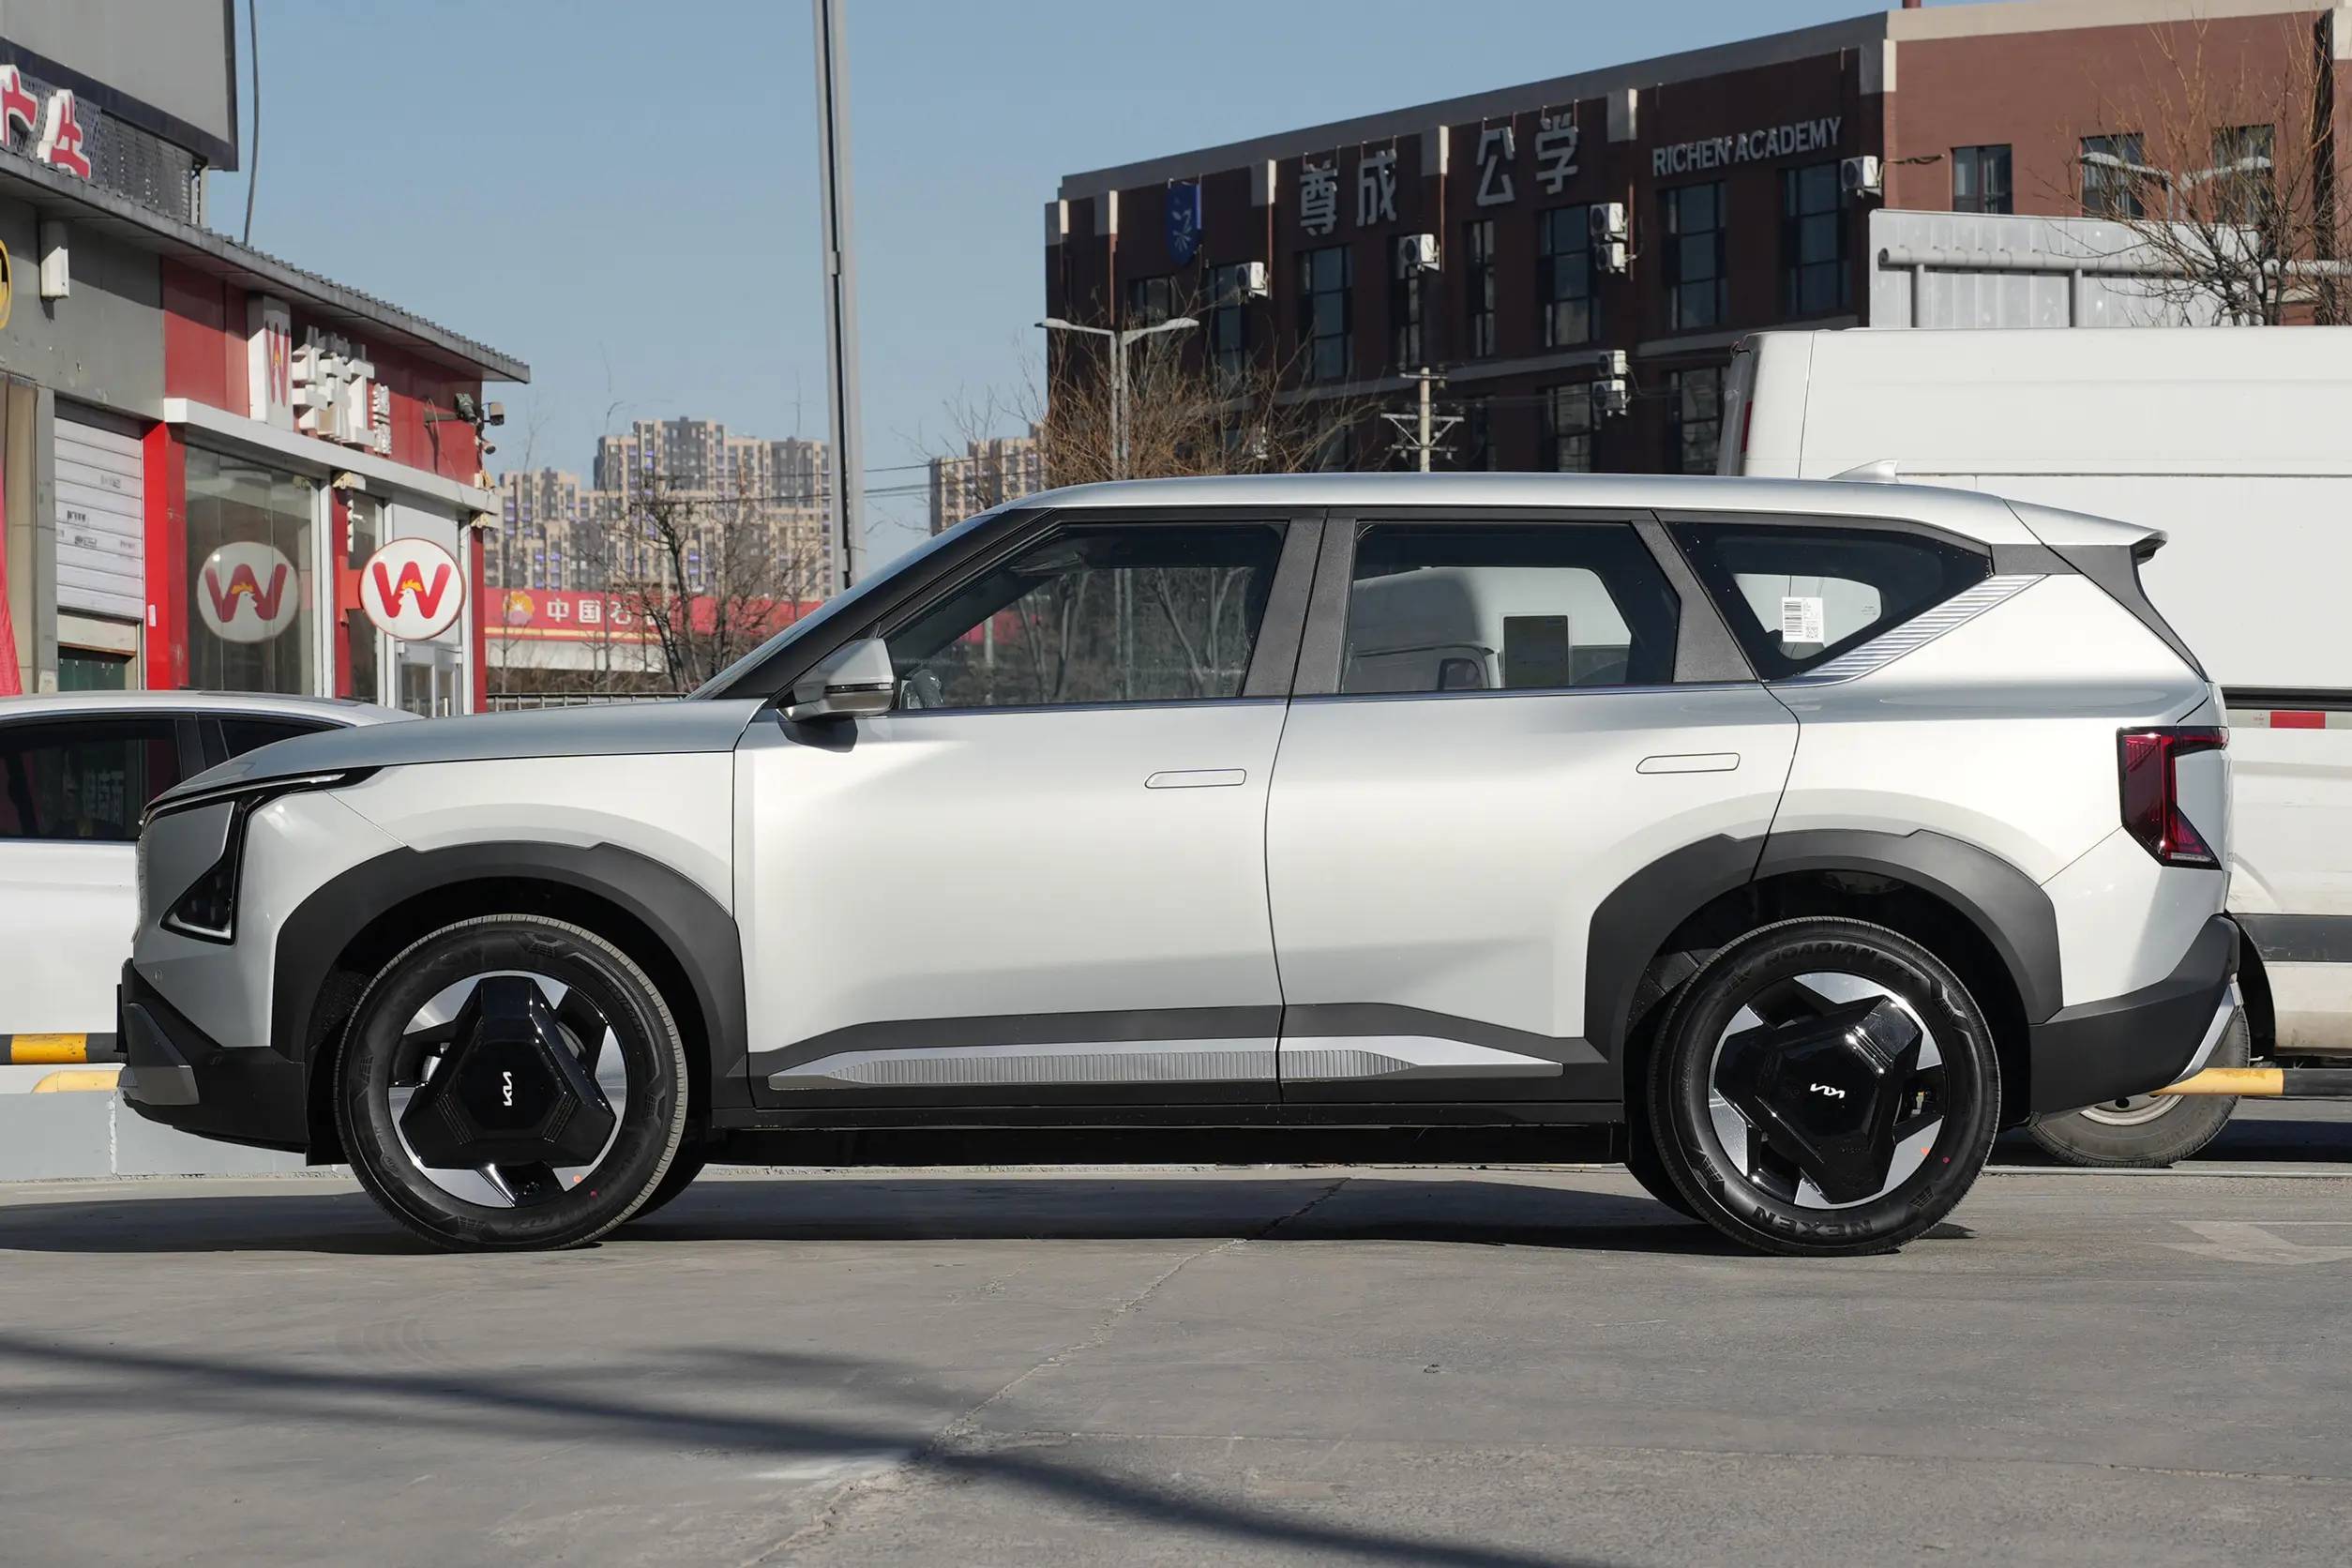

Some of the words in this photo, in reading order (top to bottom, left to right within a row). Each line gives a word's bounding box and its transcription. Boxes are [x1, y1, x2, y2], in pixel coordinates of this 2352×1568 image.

[1652, 136, 1732, 177] RICHEN
[1735, 116, 1842, 163] ACADEMY
[372, 561, 451, 619] W
[1752, 1206, 1875, 1238] NEXEN
